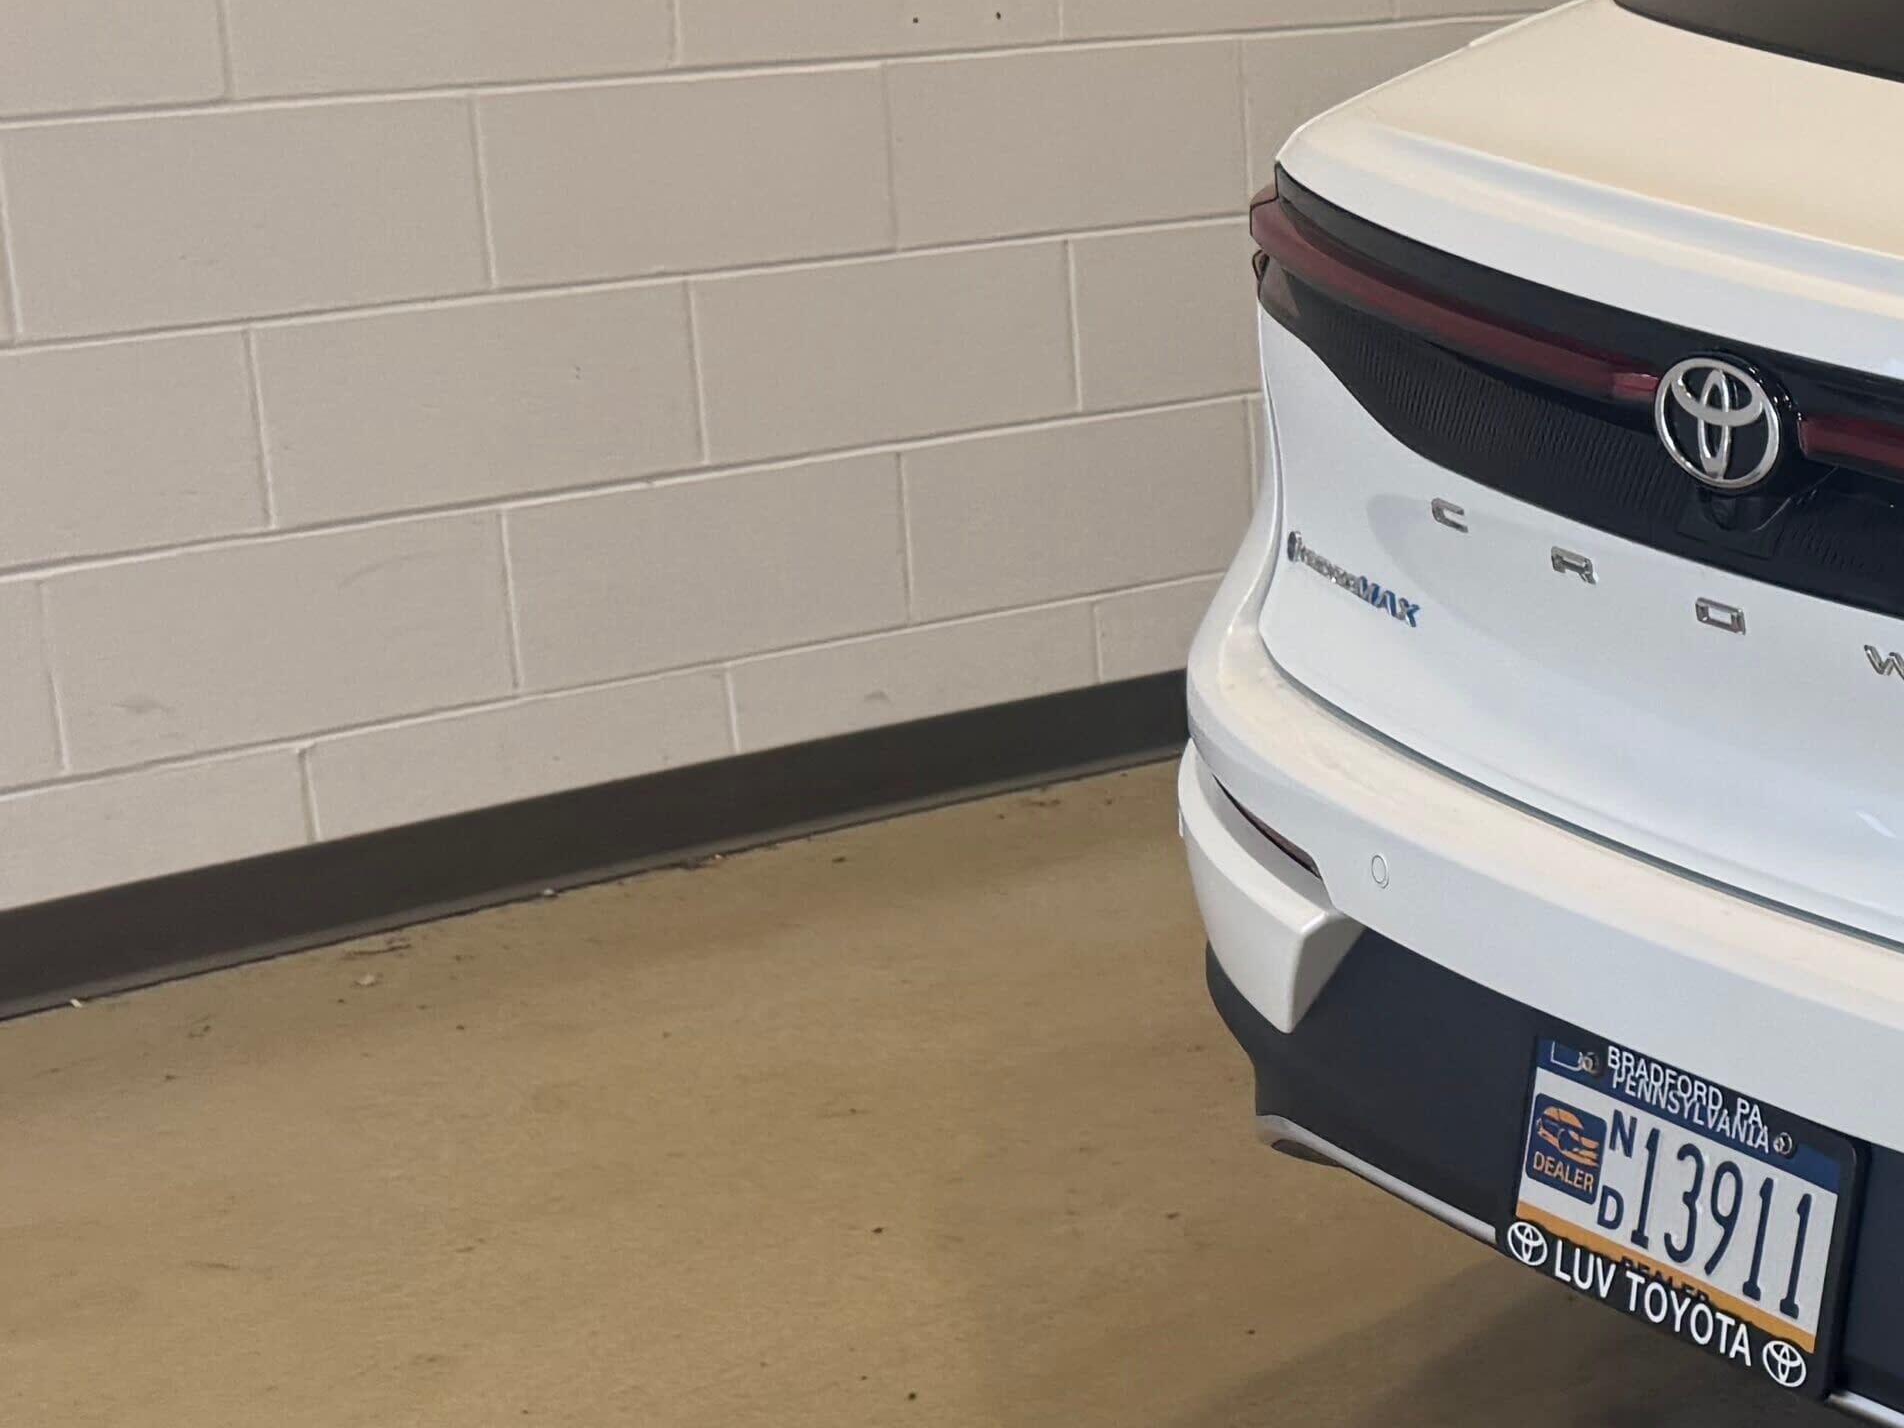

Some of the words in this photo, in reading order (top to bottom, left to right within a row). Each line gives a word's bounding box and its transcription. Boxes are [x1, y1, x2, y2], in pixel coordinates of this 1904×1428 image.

[1612, 1068, 1769, 1154] PENNSYLVANIA
[1737, 1096, 1764, 1130] PA
[1532, 1154, 1596, 1193] DEALER
[1631, 1127, 1812, 1320] 13911
[1555, 1239, 1616, 1300] LUV
[1625, 1271, 1752, 1367] TOYOTA
